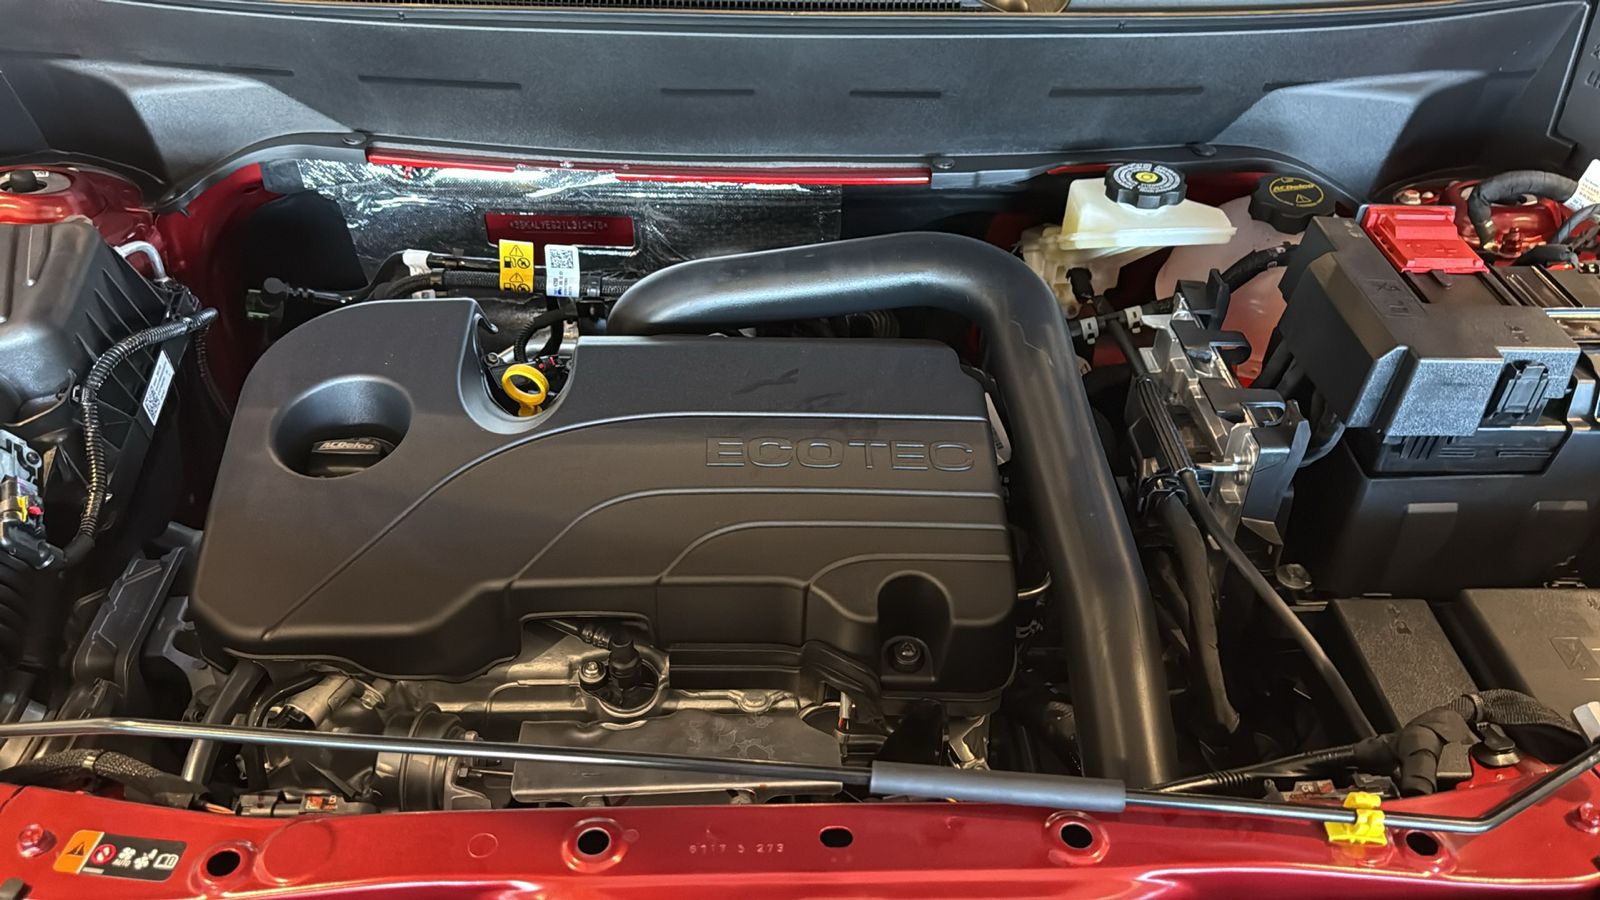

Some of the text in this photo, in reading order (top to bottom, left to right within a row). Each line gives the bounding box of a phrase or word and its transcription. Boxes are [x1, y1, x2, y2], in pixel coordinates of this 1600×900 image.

[317, 441, 375, 451] ACDelco
[706, 436, 975, 472] ECOTEC
[111, 858, 132, 868] AUTO
